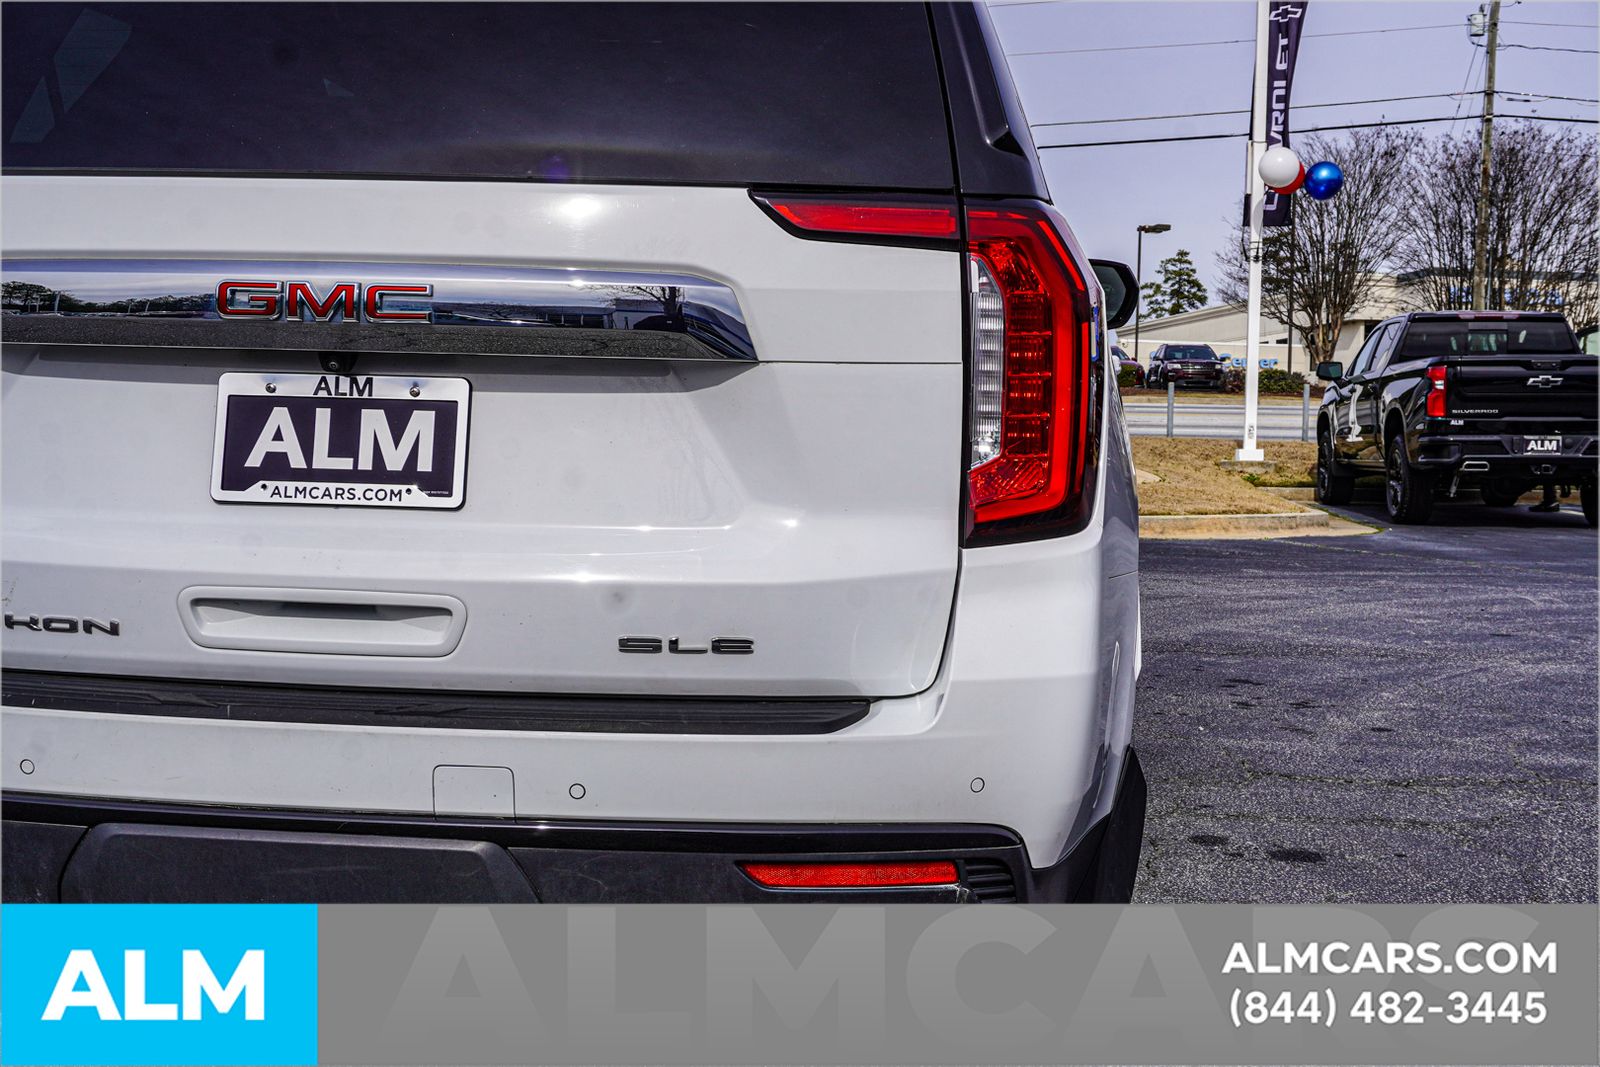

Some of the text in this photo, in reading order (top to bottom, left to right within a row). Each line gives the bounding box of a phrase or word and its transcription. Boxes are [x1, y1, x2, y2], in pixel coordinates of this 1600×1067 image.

[216, 280, 434, 323] GMC
[313, 376, 373, 397] ALM
[244, 407, 436, 472] ALM
[1527, 440, 1557, 451] ALM
[270, 485, 403, 502] ALMCARS.COM
[618, 636, 754, 654] SLE
